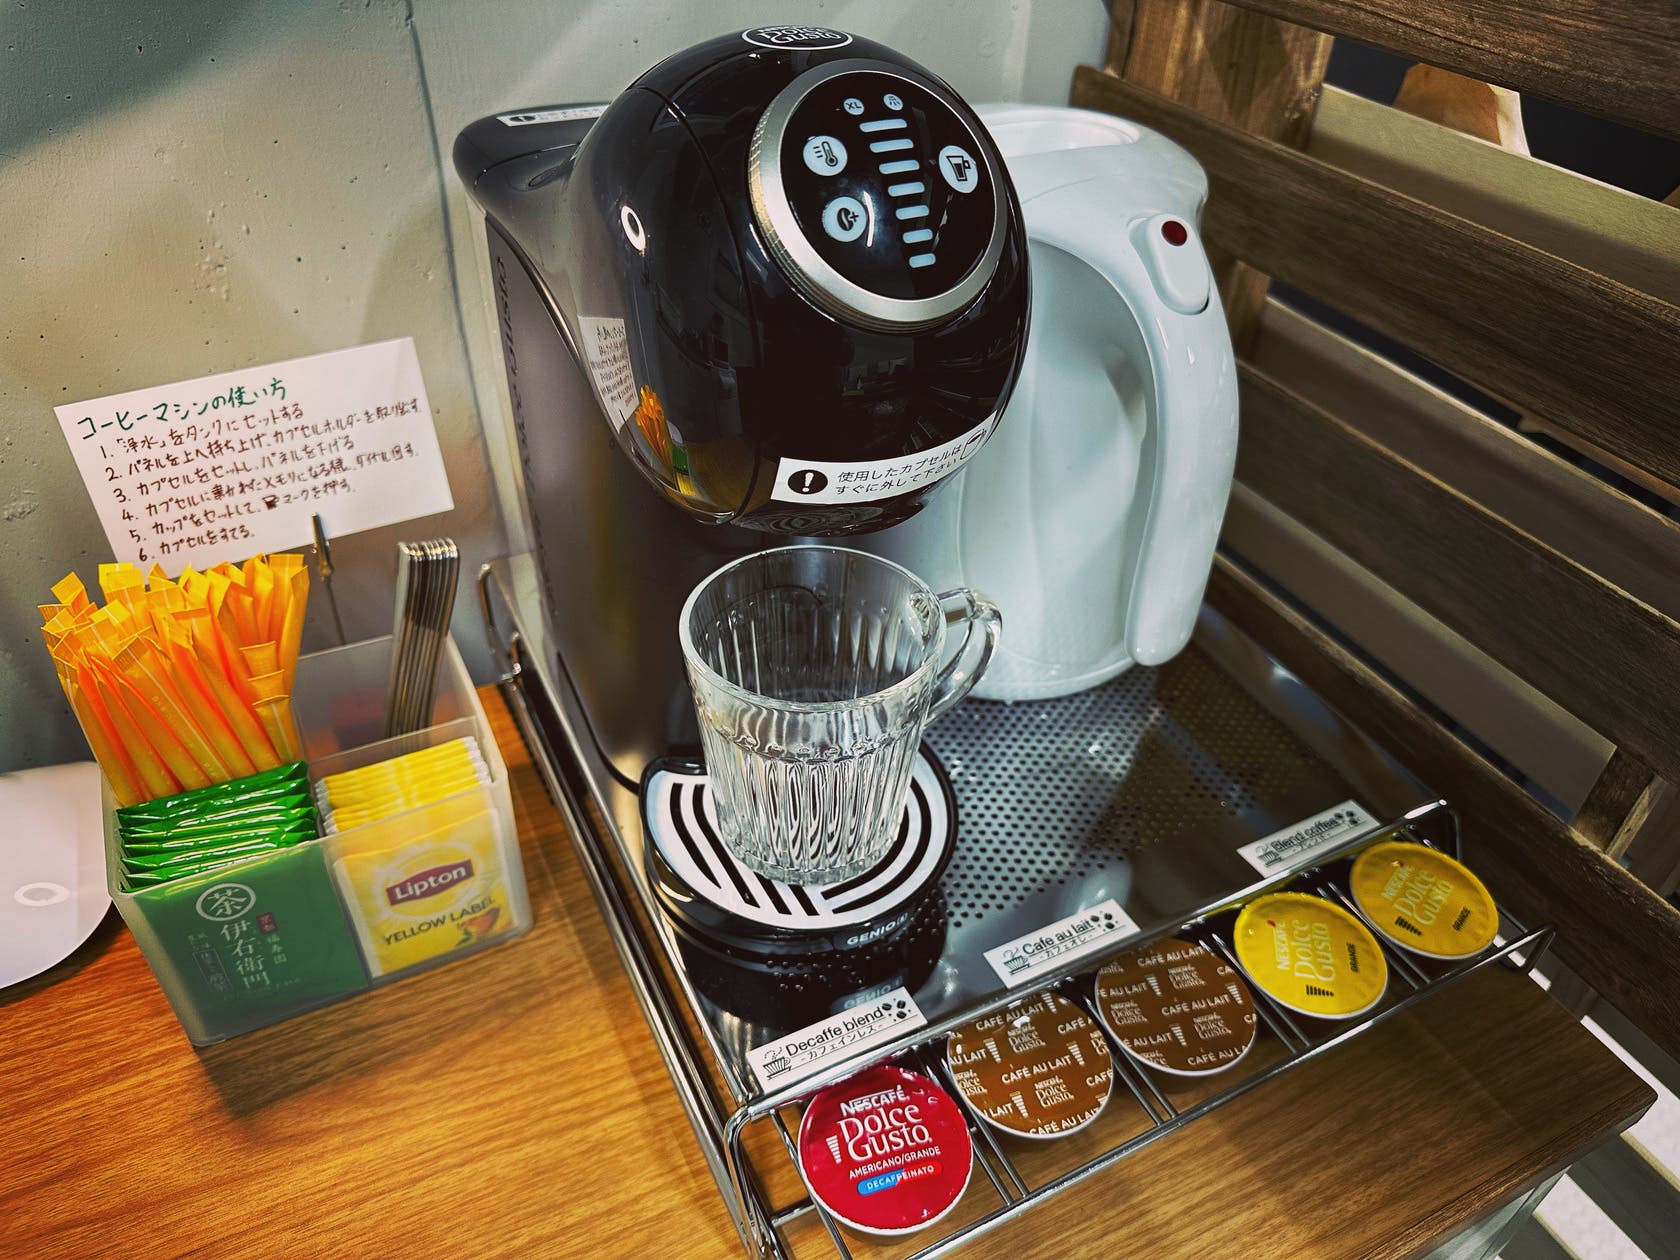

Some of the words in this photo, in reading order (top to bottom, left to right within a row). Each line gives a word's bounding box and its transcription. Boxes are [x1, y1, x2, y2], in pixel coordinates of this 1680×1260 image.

[845, 101, 862, 110] XL
[77, 378, 286, 440] コーヒーマシンの使い方
[104, 467, 123, 482] 2.
[834, 456, 958, 495] すぐに外して下さい
[837, 444, 962, 483] 使用したカプセルは
[112, 488, 132, 504] 3.
[121, 509, 140, 522] 4.
[128, 528, 147, 544] 5.
[138, 547, 156, 562] 6.
[394, 866, 467, 900] Lipton
[207, 888, 248, 916] 茶
[383, 915, 447, 945] YELLOW
[846, 920, 896, 945] GENIO
[1022, 937, 1054, 955] Cafe
[1055, 930, 1072, 942] au
[1070, 919, 1094, 935] lait
[220, 920, 271, 989] 伊右衛門
[1166, 951, 1181, 962] AU
[1291, 920, 1316, 978] Dolce
[1312, 922, 1336, 982] Gusto
[1109, 986, 1124, 997] AU
[1125, 982, 1147, 995] LAIT
[1191, 999, 1207, 1011] AU
[1208, 993, 1230, 1008] LAIT
[1005, 1008, 1026, 1022] AU
[1026, 1002, 1045, 1017] LAIT
[785, 1025, 843, 1057] Decaffe
[843, 1007, 884, 1033] blend
[1057, 1016, 1086, 1034] CAFÉ
[1133, 1036, 1148, 1048] AU
[1150, 1032, 1172, 1045] LAIT
[963, 1048, 987, 1063] LAIT
[1218, 1048, 1234, 1060] AU
[1001, 1067, 1031, 1085] CAFÉ
[1032, 1062, 1049, 1076] AU
[1050, 1054, 1073, 1070] LAIT
[959, 1077, 980, 1089] olce
[840, 1085, 910, 1116] NESCAFÉ
[989, 1102, 1014, 1118] LAIT
[837, 1104, 923, 1144] Dolce
[1061, 1116, 1077, 1129] AU
[848, 1124, 932, 1161] Gusto
[849, 1146, 941, 1180] AMERICANO/GRANDE
[866, 1165, 934, 1191] DECAFFEINATO
